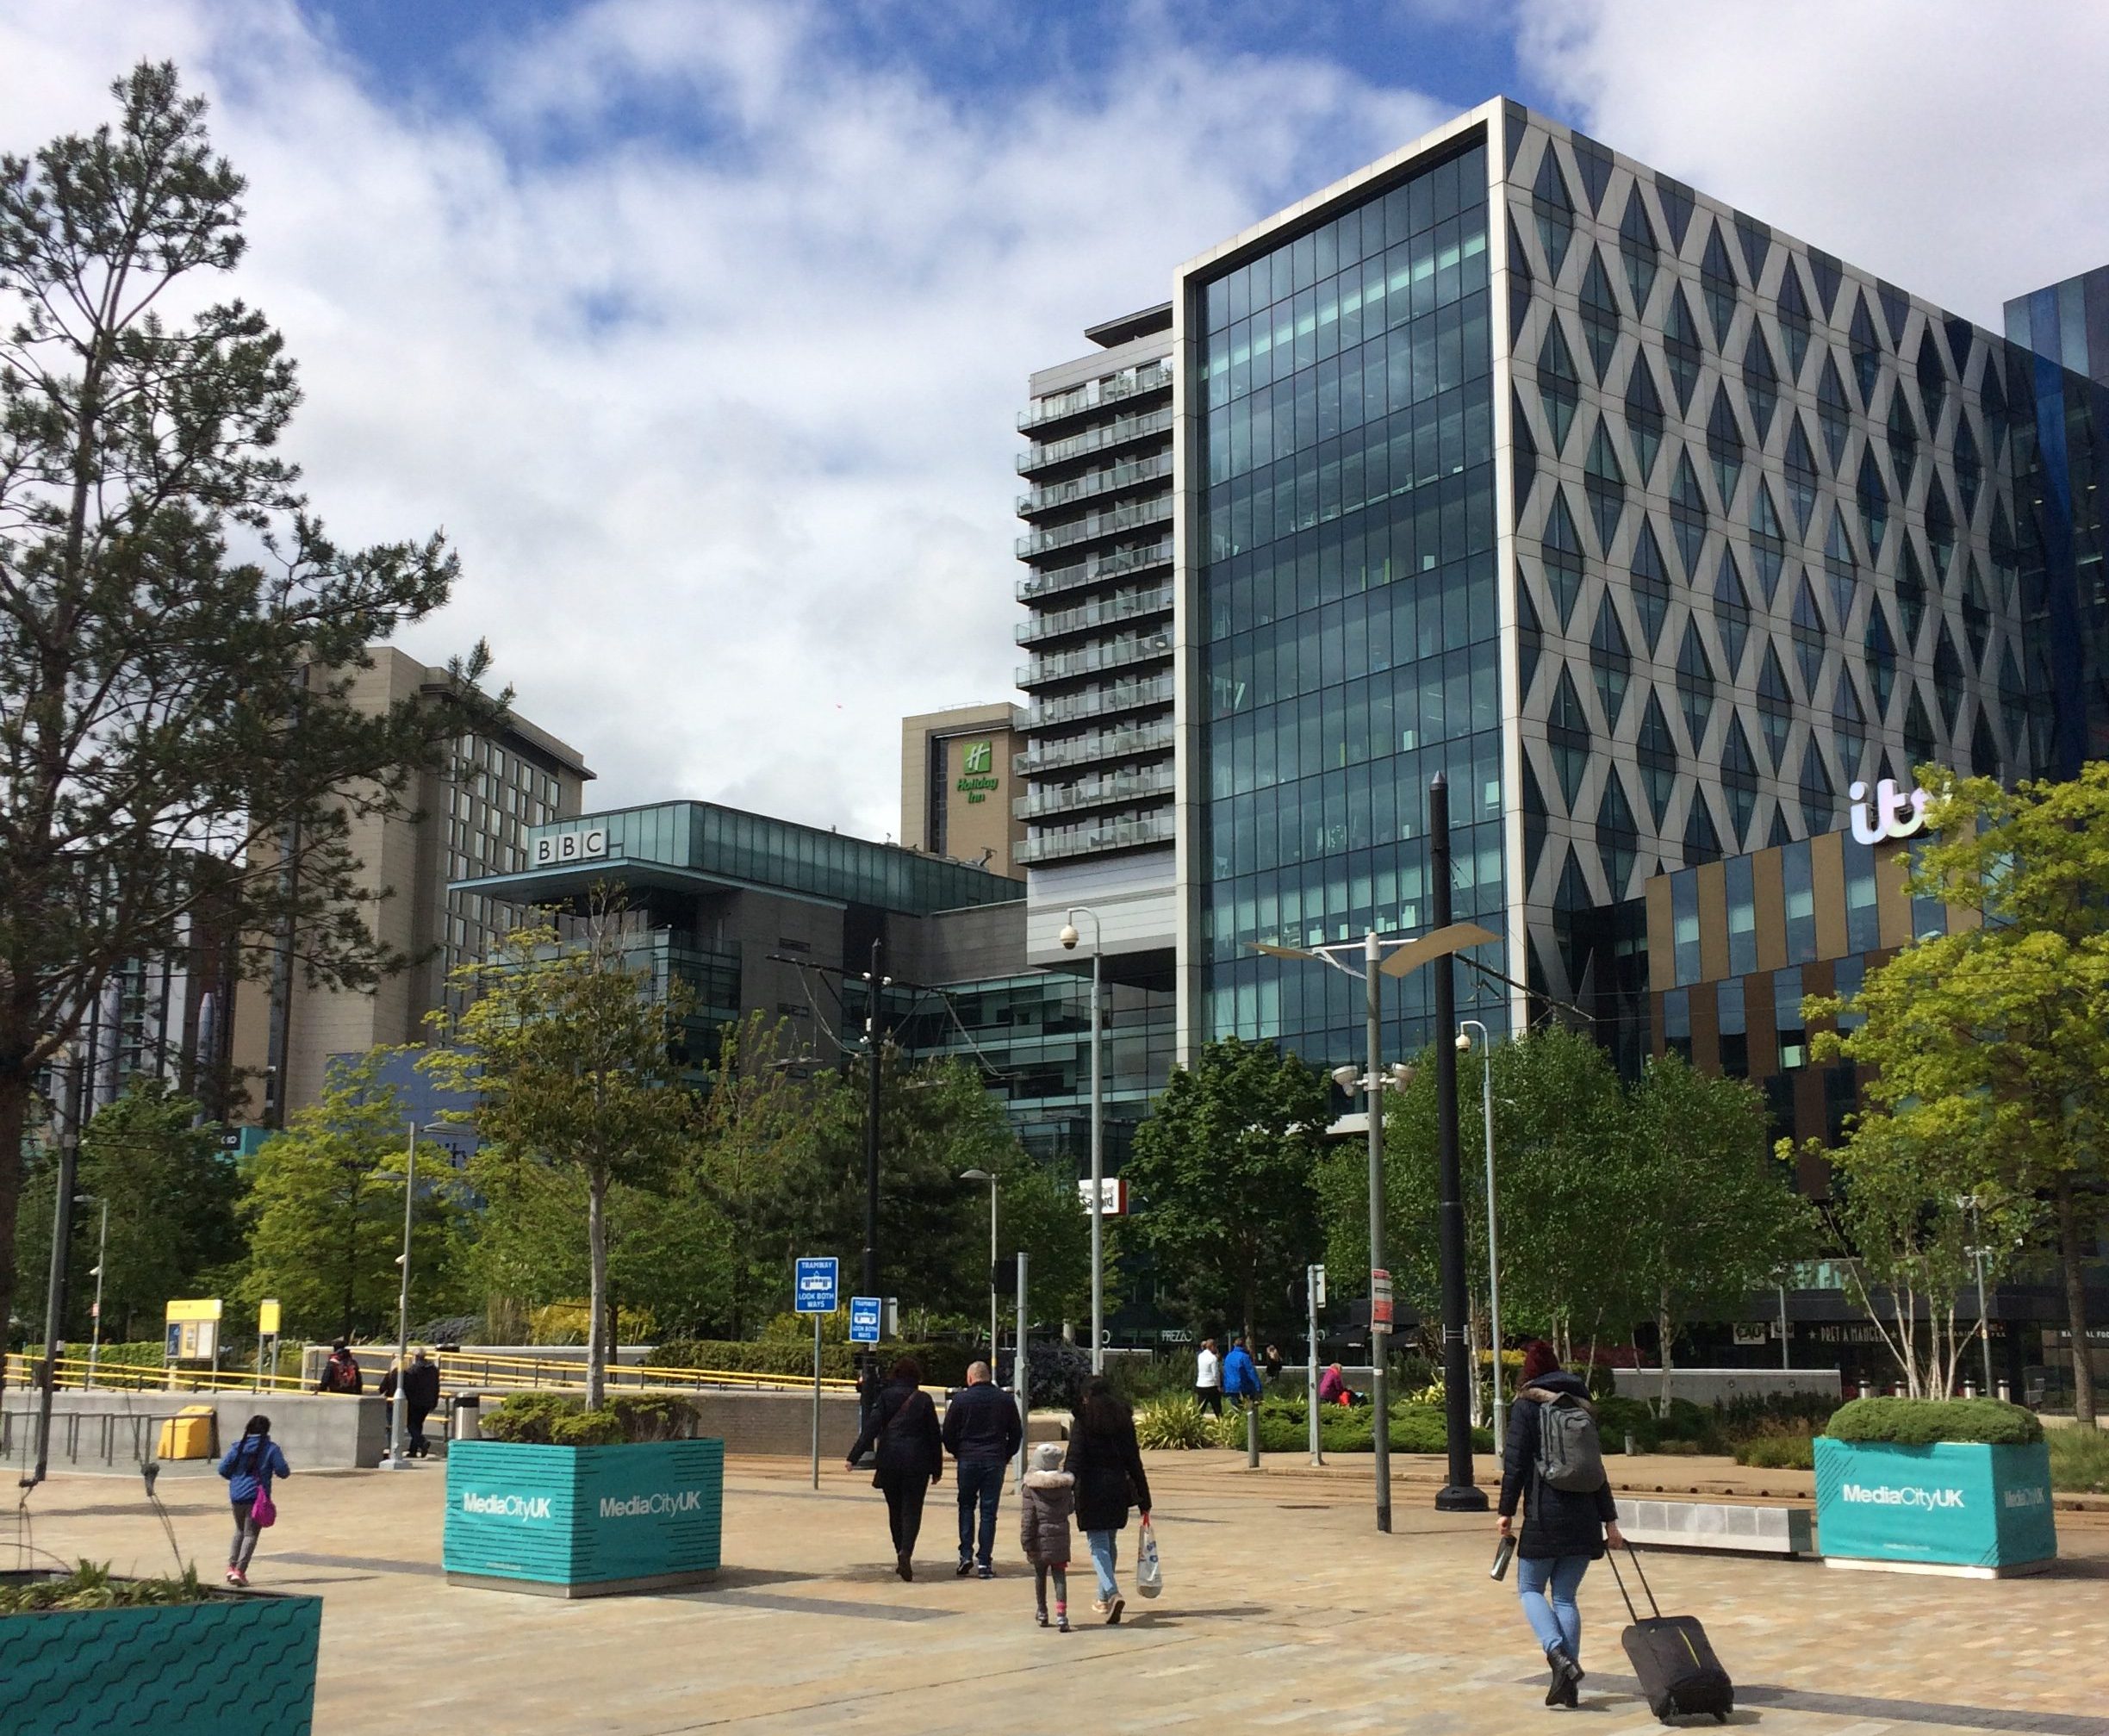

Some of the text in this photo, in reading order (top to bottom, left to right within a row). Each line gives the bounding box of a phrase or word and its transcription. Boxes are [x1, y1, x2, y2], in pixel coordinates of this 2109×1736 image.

[957, 777, 999, 792] Holiday
[967, 791, 986, 804] Inn
[539, 832, 602, 861] BBC
[1081, 1194, 1113, 1209] Sard
[1161, 1329, 1192, 1341] PREZZO
[1820, 1326, 1840, 1342] PRET
[600, 1490, 701, 1518] MediaCityUK
[1843, 1484, 1965, 1511] MediaCityUK
[463, 1492, 551, 1522] MediaCityUK
